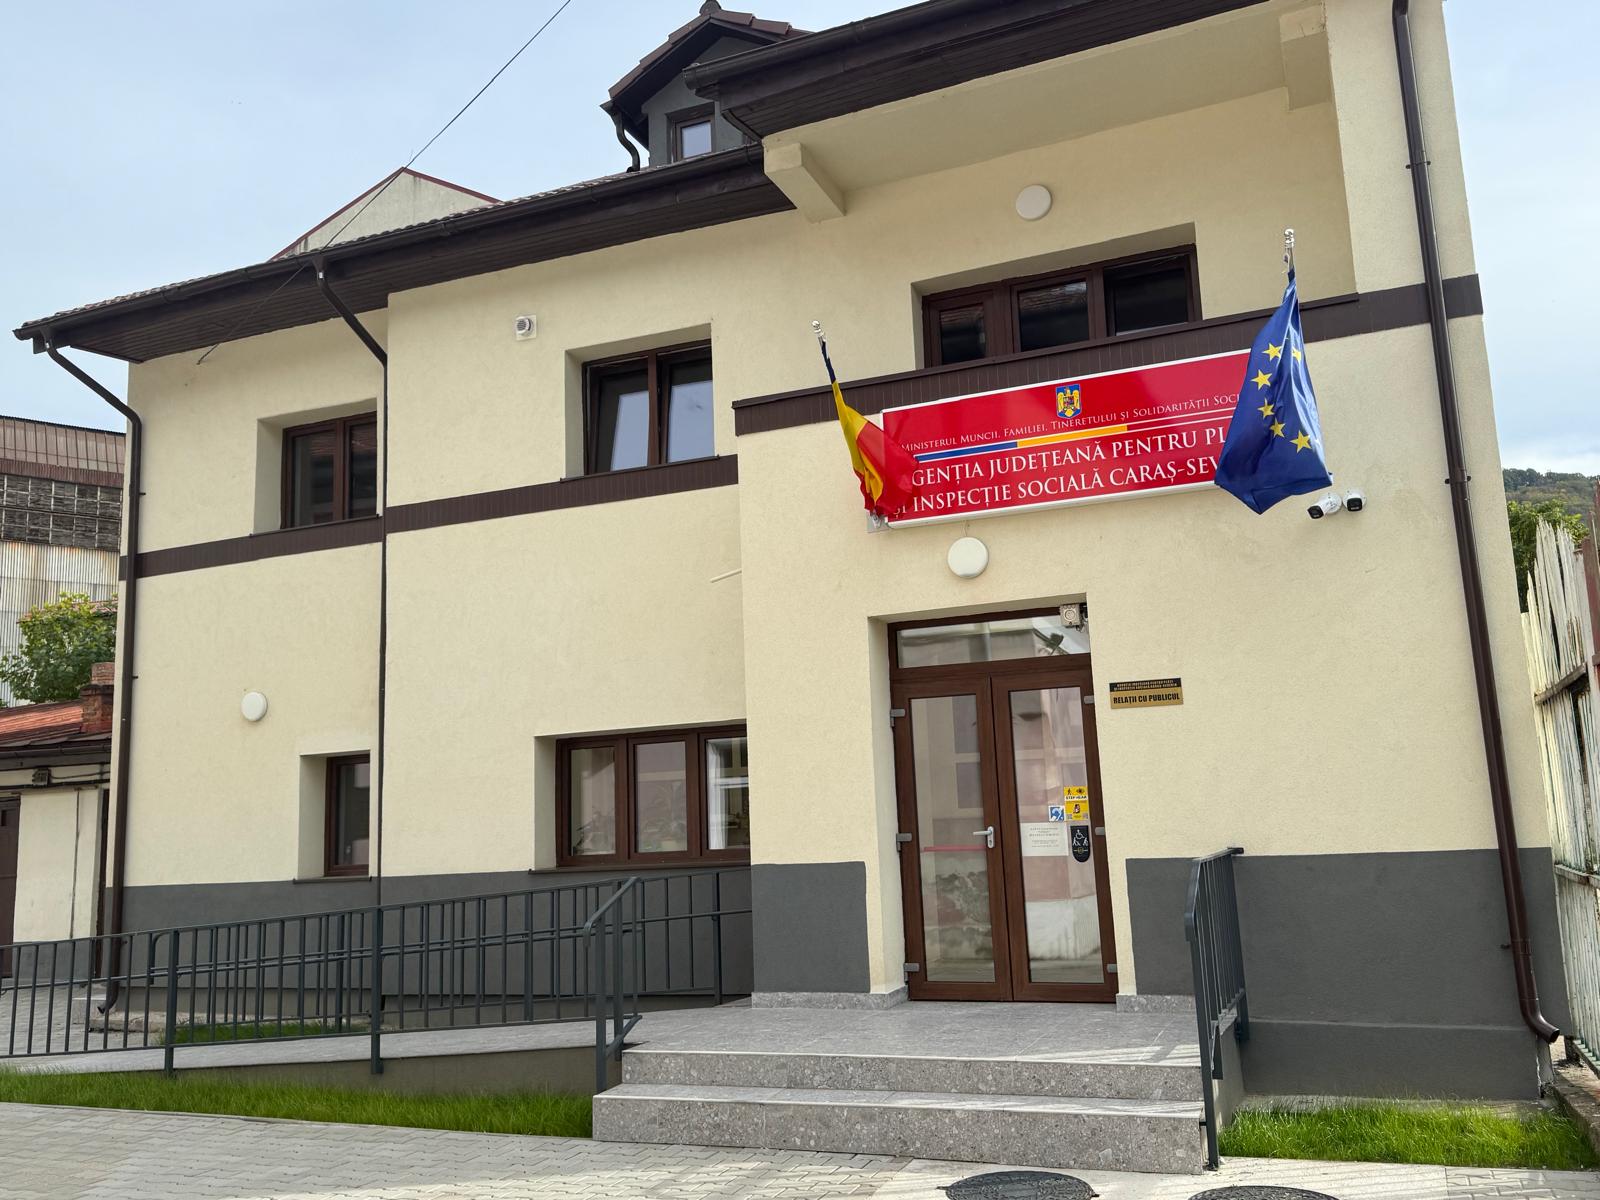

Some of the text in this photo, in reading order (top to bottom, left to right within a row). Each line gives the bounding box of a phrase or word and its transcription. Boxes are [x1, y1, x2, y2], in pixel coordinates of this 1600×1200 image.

[901, 437, 957, 451] MINISTERUL
[1051, 413, 1117, 430] TINERETULUI
[1120, 411, 1129, 421] ȘI
[1133, 398, 1209, 418] SOLIDARITĂȚII
[1213, 393, 1240, 406] SOCI
[912, 426, 1226, 486] GENȚIA JUDEȚEANĂ PENTRU PL
[913, 484, 1012, 512] INSPECȚIE
[1018, 467, 1104, 499] SOCIALĂ
[1110, 456, 1218, 487] CARAȘ-SEV
[1113, 693, 1180, 704] RELAȚII CU PUBLICUL
